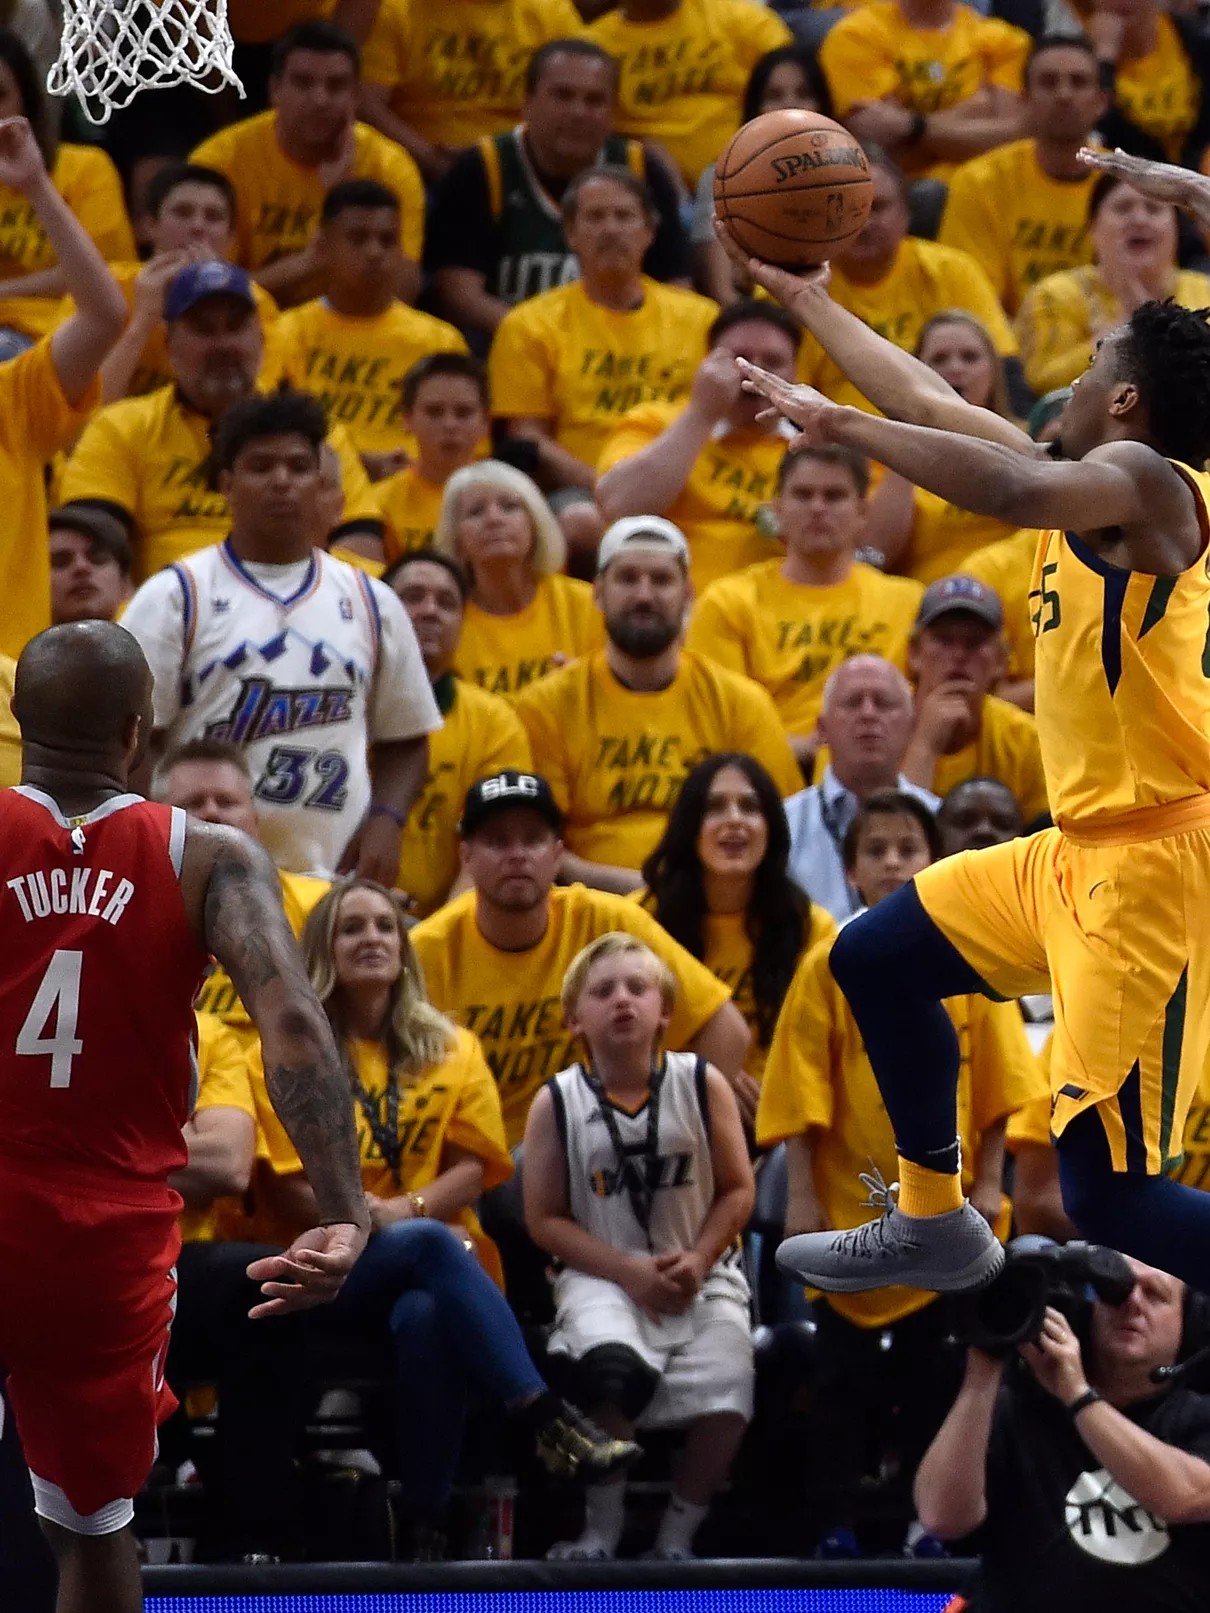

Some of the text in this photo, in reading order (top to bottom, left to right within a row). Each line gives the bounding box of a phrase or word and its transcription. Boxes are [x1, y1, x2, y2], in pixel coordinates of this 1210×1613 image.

[255, 745, 350, 812] 32
[7, 867, 135, 926] TUCKER
[16, 949, 83, 1088] 4
